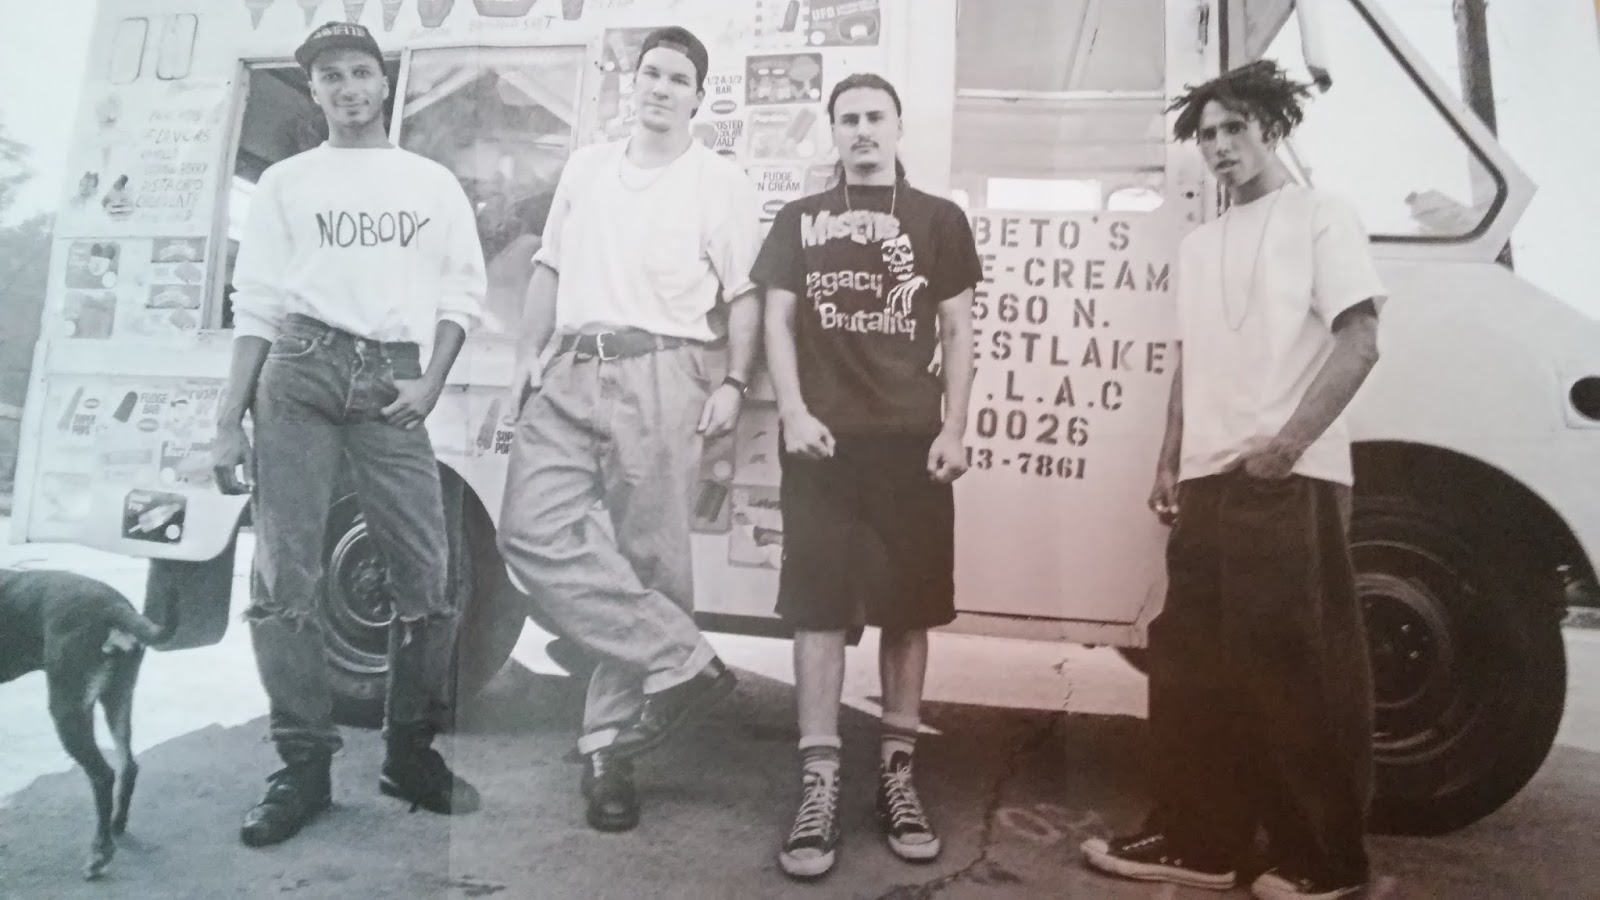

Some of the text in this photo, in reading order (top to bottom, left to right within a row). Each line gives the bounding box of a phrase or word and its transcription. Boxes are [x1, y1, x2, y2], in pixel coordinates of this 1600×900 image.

[715, 86, 732, 95] BAR
[715, 120, 744, 130] OSTED
[763, 171, 792, 181] FUDGE
[768, 181, 801, 192] CREAM
[315, 210, 431, 249] NOBODY
[972, 216, 1130, 251] BETO'S
[818, 302, 917, 342] Brutality
[970, 292, 1110, 329] 560 N.
[976, 407, 1090, 447] 0026
